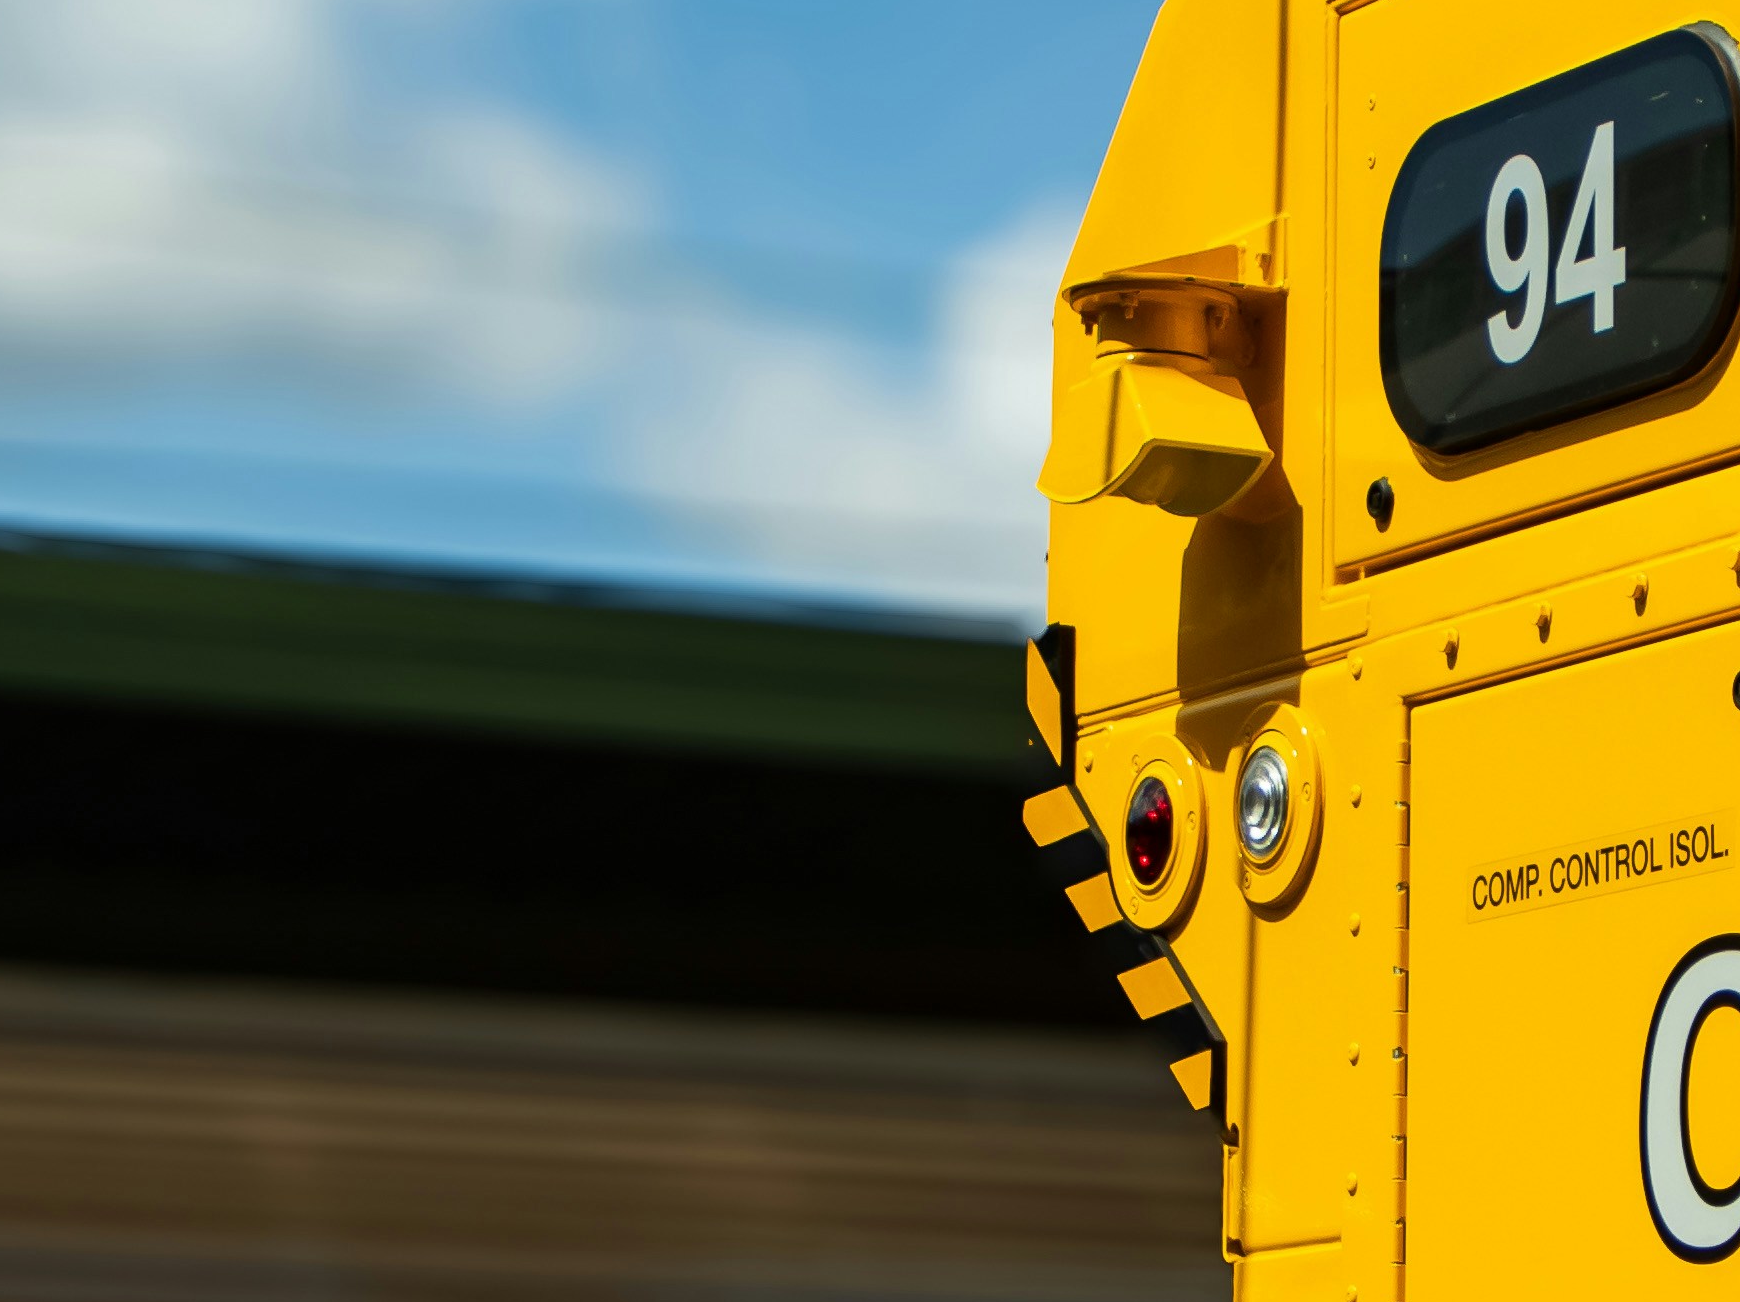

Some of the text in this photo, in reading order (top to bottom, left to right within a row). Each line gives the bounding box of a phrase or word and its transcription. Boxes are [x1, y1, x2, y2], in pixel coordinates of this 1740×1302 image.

[1485, 120, 1626, 364] 94
[1472, 824, 1729, 911] COMP. CONTROL ISOL.
